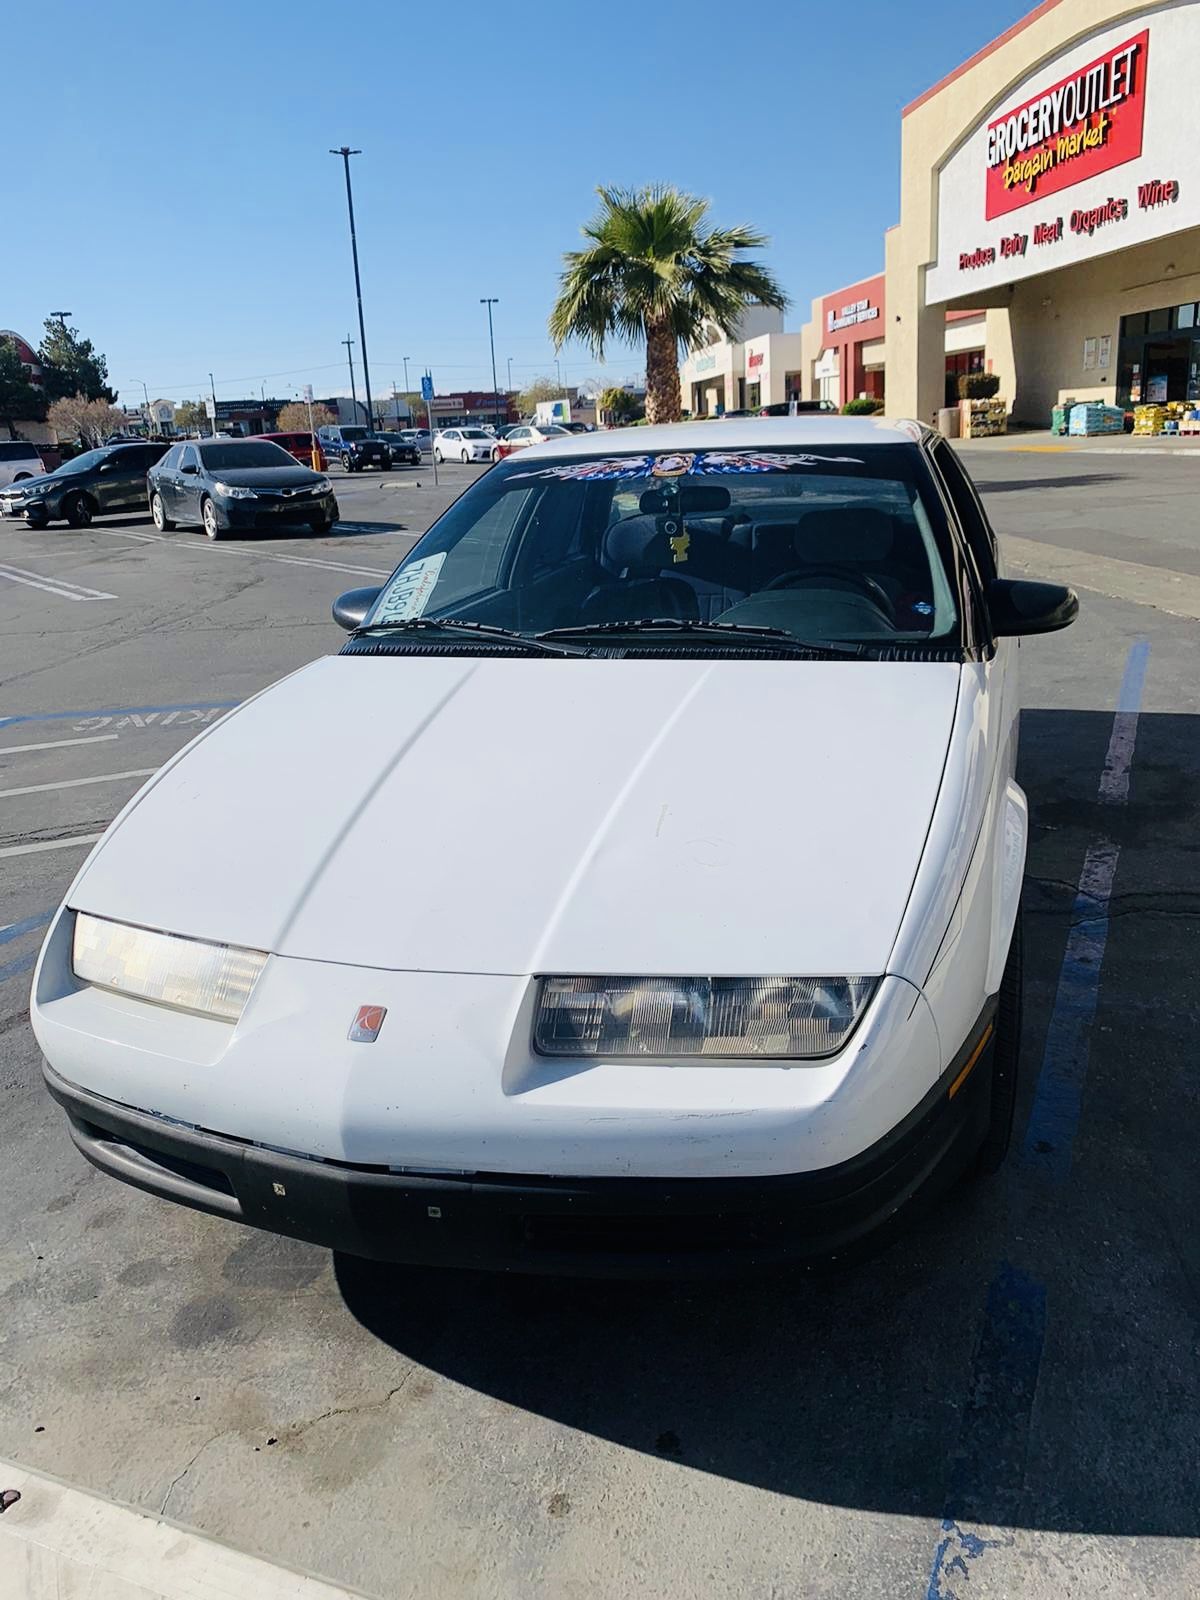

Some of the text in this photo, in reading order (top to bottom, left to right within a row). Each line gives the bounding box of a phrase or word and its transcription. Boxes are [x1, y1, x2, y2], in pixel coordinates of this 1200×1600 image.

[1002, 113, 1108, 192] bargain market
[959, 180, 1177, 270] Produce Dairy Meat Organics Wine
